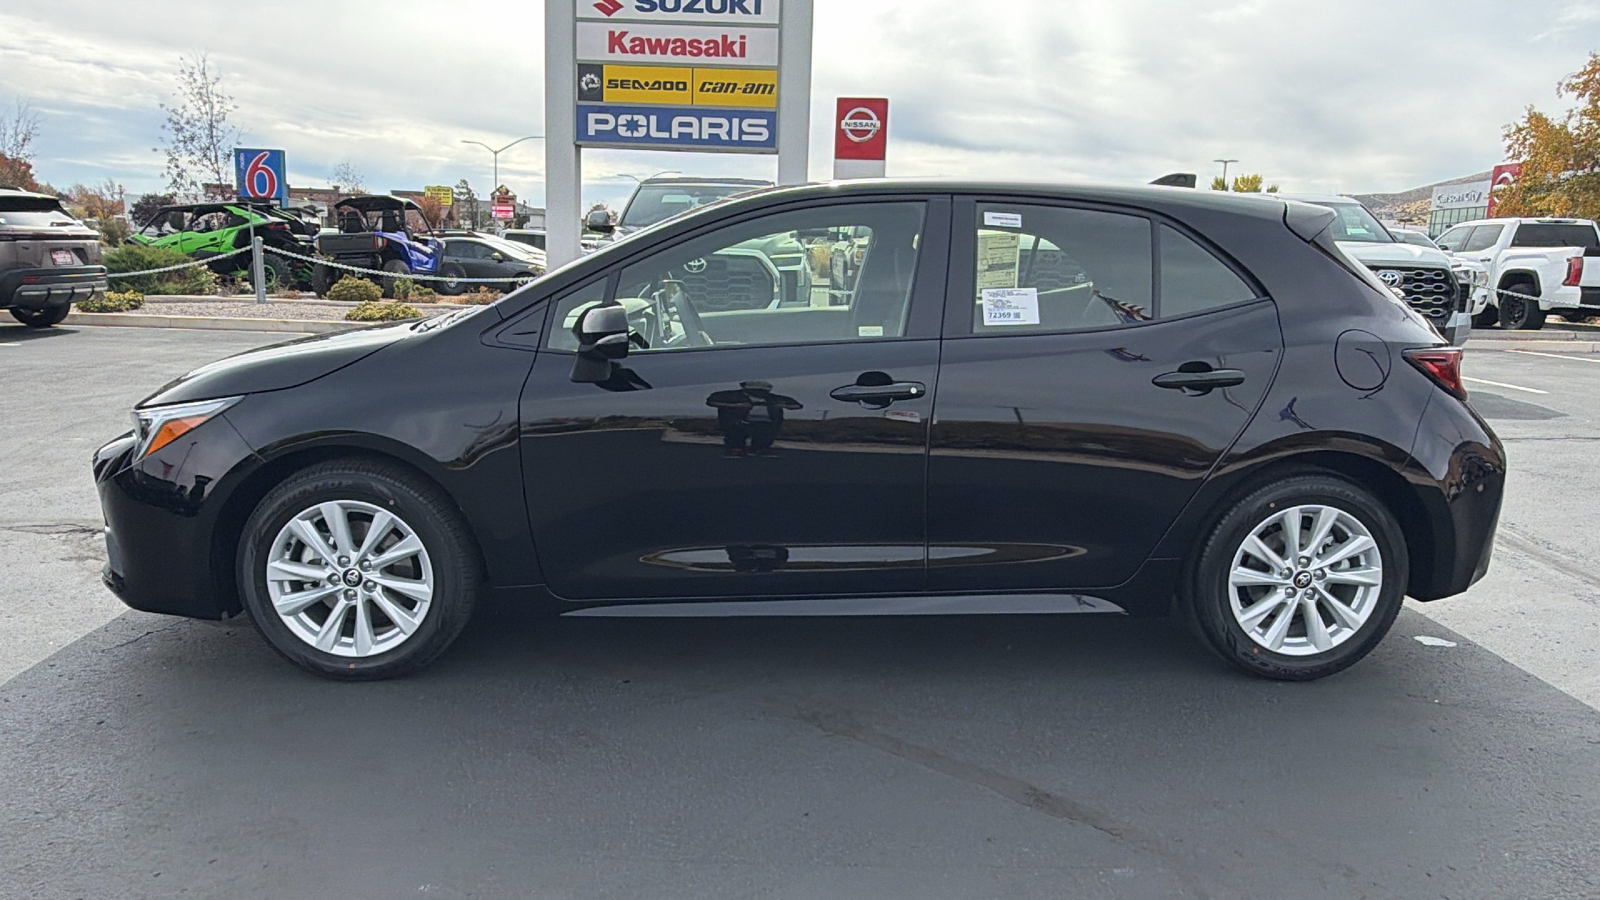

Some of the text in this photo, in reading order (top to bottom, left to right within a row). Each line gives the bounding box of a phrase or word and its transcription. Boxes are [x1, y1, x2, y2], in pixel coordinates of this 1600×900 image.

[608, 31, 746, 58] Kawasaki
[699, 81, 774, 95] can-am
[587, 113, 768, 141] POLARIS
[245, 151, 277, 198] 6
[1437, 190, 1482, 204] Carson City
